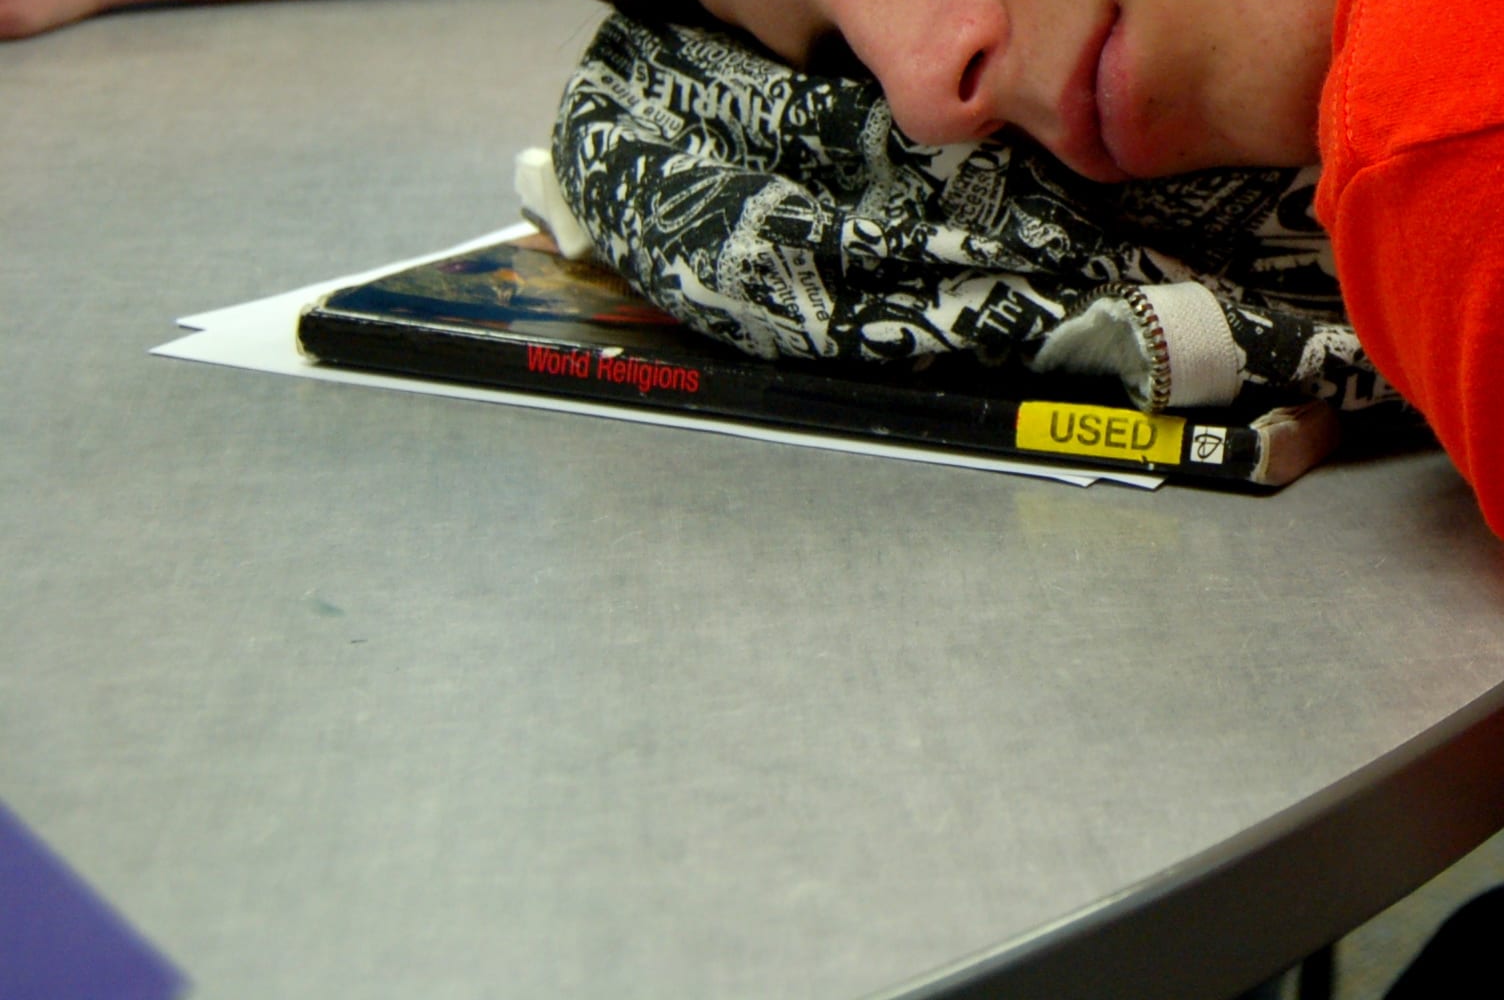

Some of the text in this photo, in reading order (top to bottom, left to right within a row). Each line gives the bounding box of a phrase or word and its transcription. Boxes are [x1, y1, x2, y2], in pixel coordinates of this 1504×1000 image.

[799, 268, 830, 322] future
[527, 343, 700, 393] World Religions
[1050, 411, 1158, 450] USED
